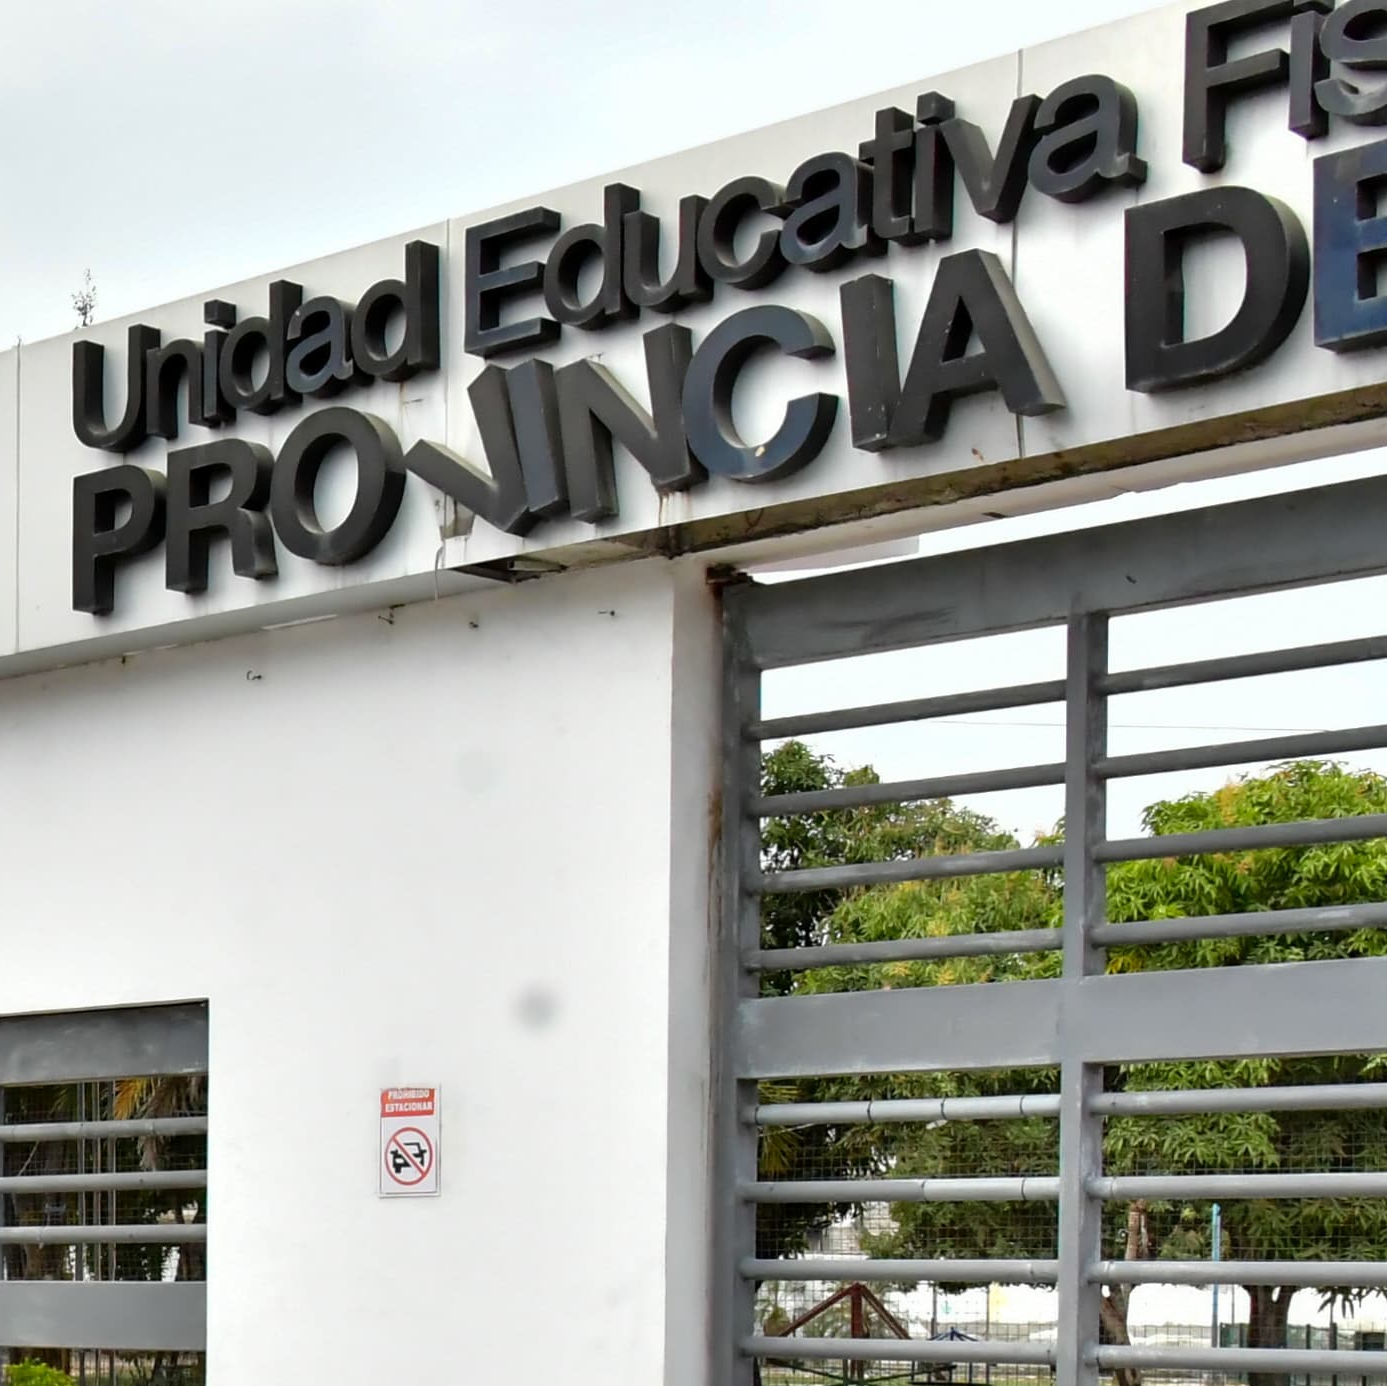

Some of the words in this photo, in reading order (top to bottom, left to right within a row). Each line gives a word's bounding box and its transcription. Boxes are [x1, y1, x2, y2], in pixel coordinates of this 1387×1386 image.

[72, 240, 440, 453] Unidad
[464, 73, 1149, 358] Educativa
[72, 247, 1067, 616] PROVINCIA
